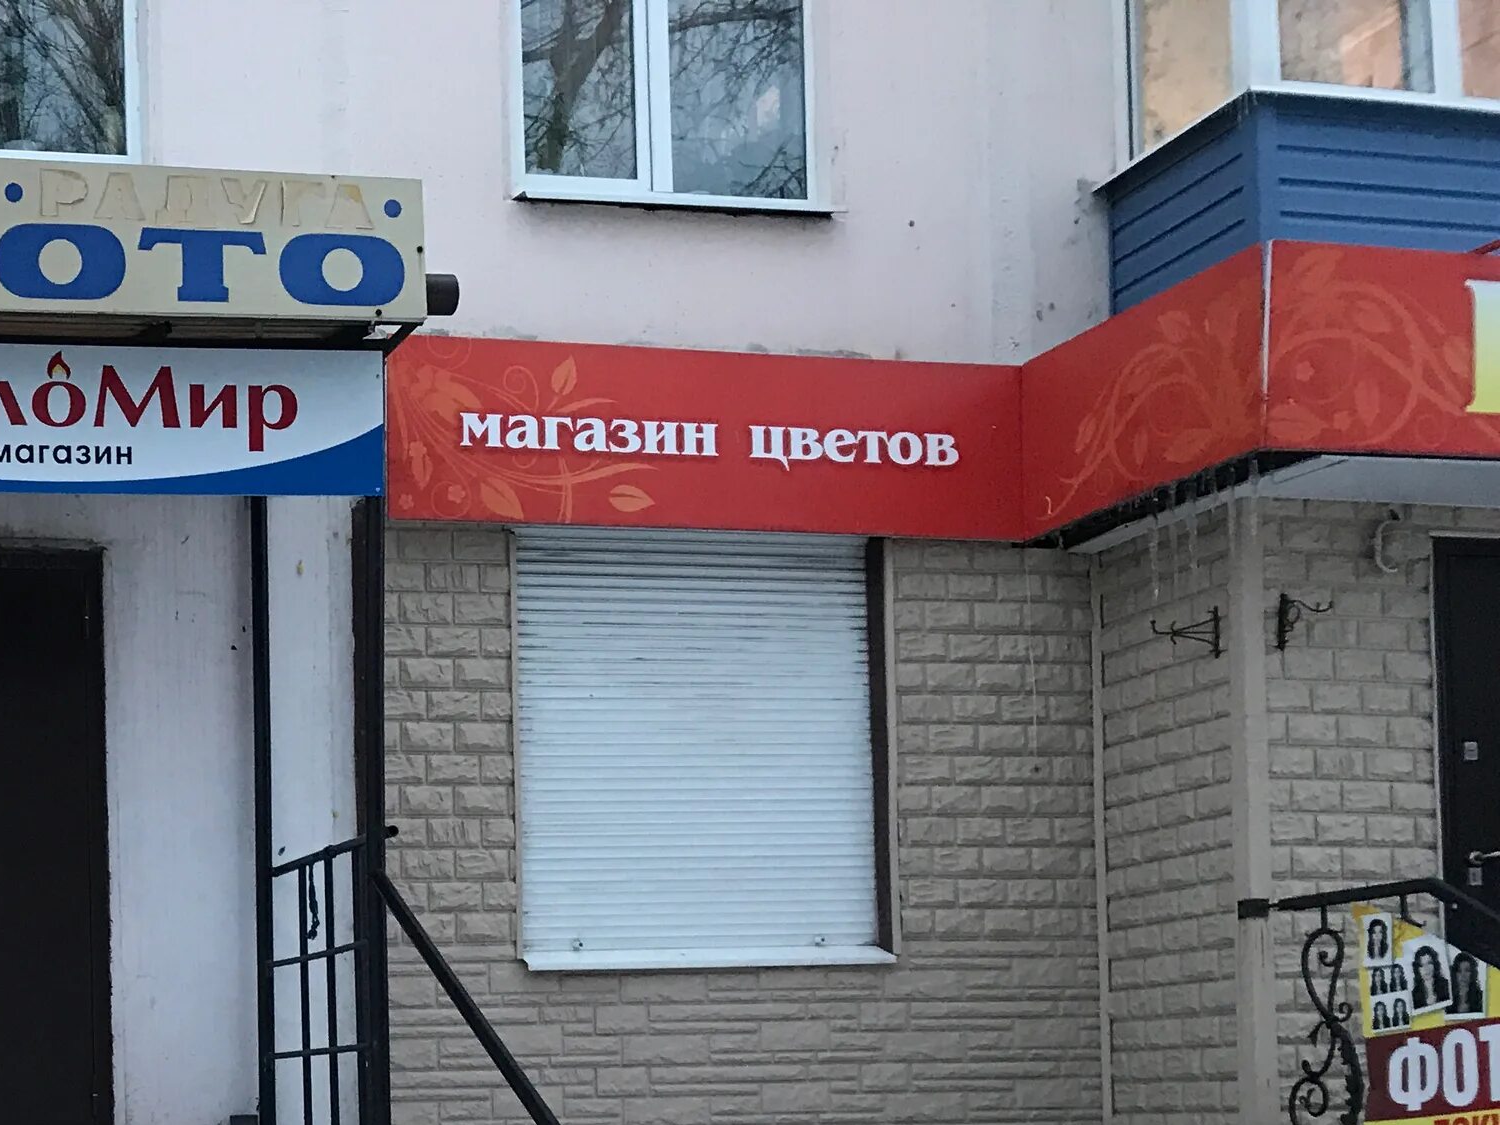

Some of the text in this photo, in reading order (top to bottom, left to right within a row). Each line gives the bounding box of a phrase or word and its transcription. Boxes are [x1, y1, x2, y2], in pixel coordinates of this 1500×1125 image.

[38, 167, 375, 230] РАДУГА
[459, 411, 960, 472] магазин цветов
